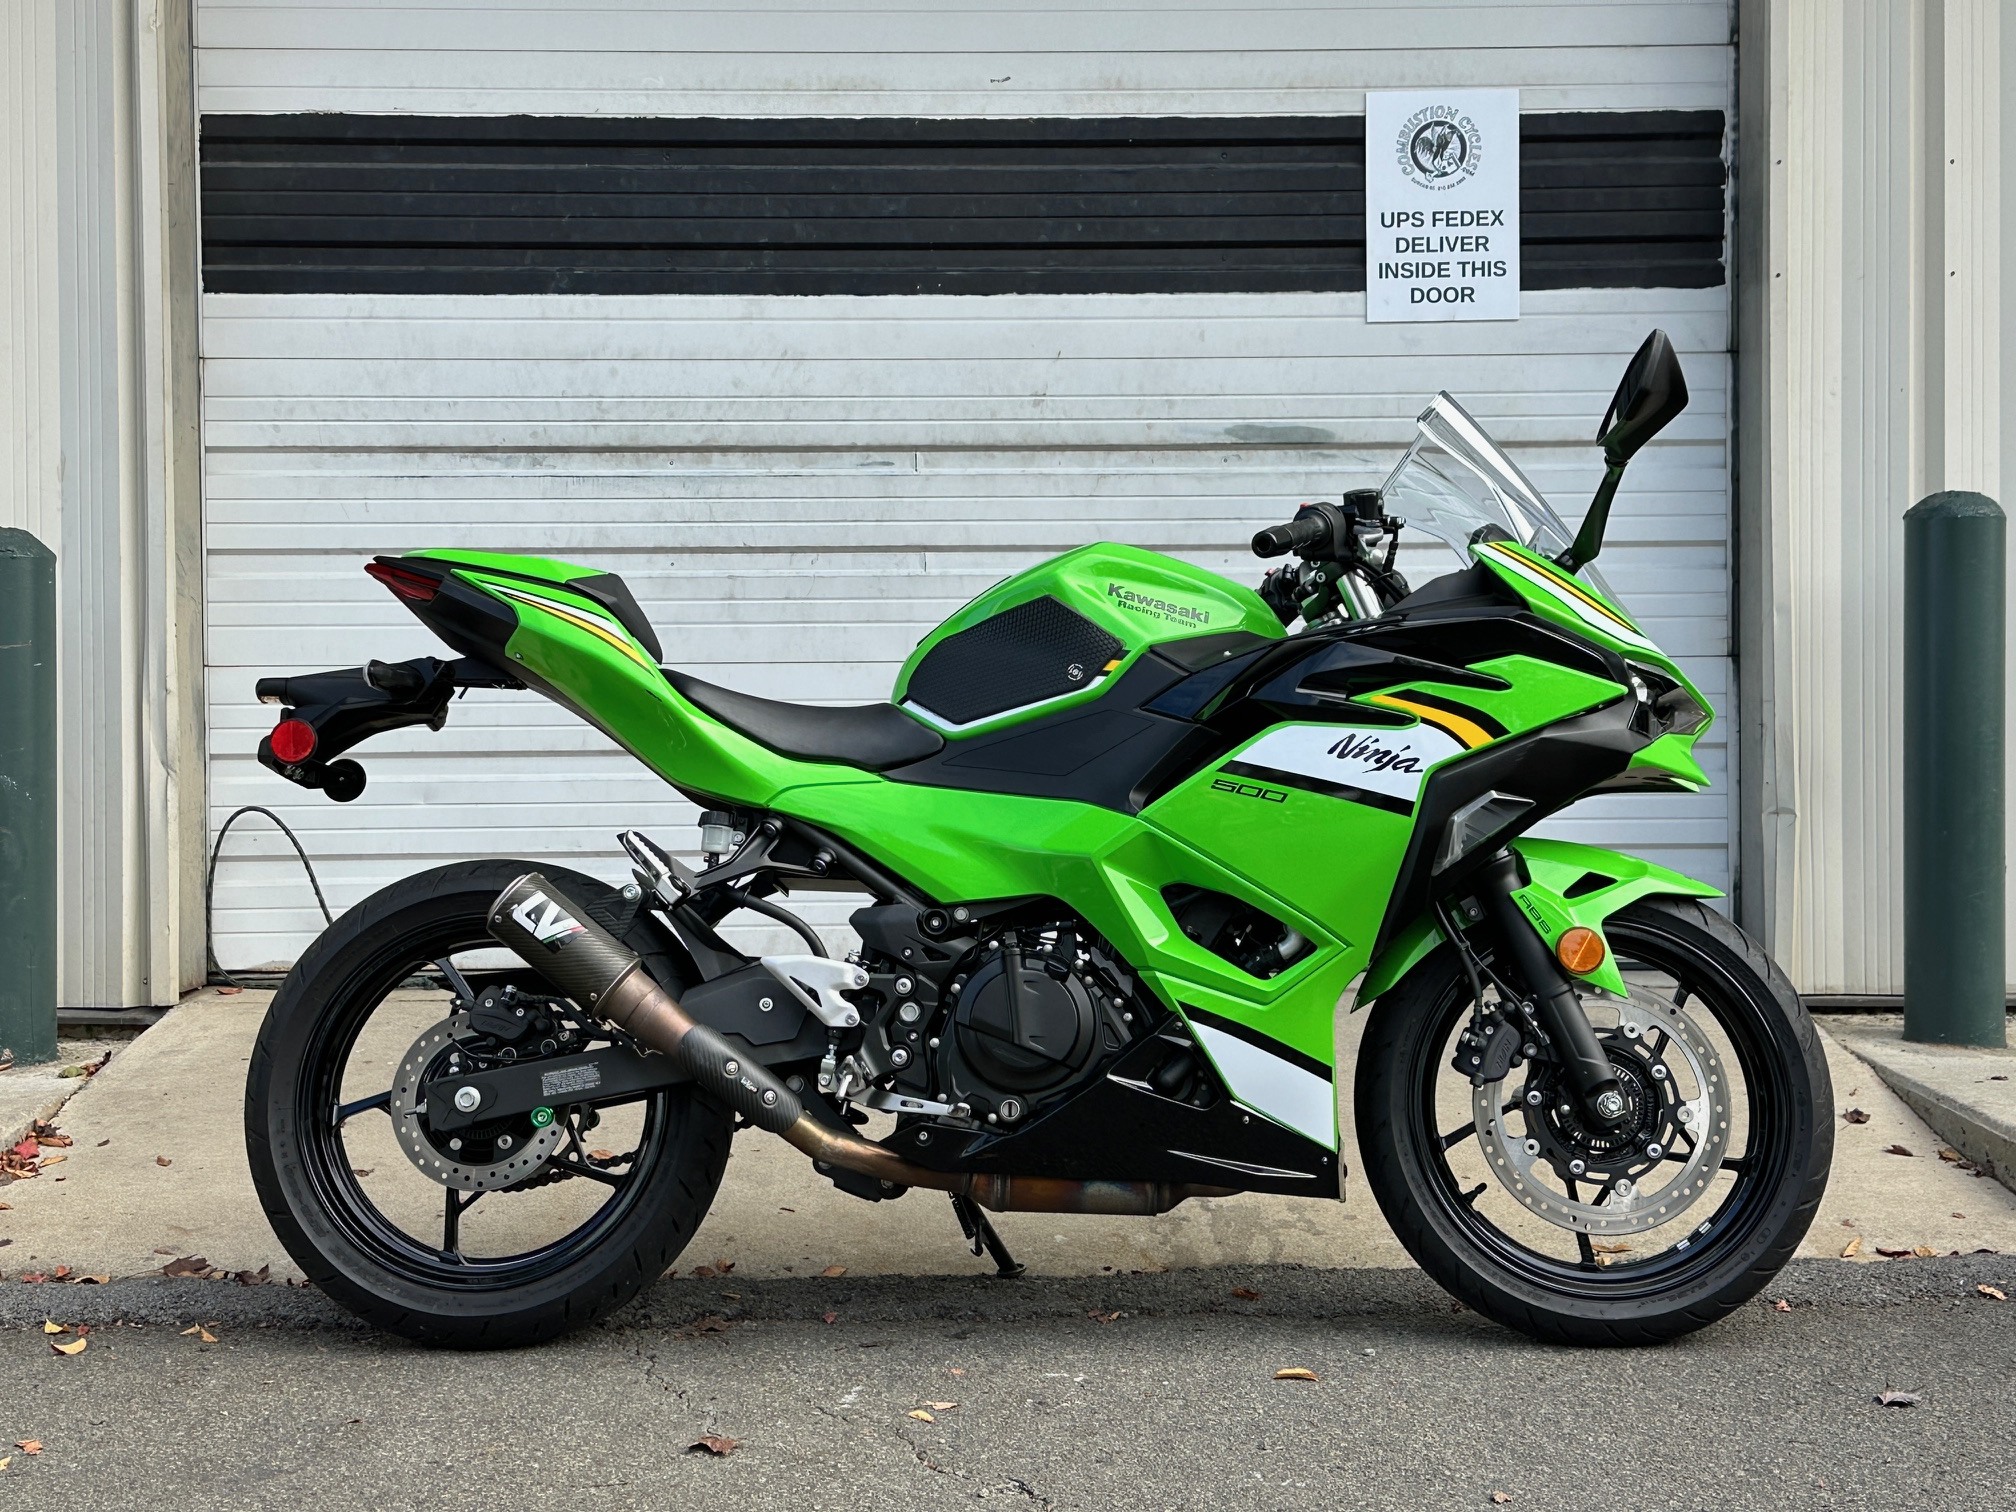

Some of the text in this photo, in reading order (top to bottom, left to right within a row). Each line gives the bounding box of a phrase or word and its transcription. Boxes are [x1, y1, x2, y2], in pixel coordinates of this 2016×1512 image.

[1396, 105, 1482, 176] COMBUSTION CYCLES
[1380, 210, 1504, 228] UPS FEDEX
[1395, 235, 1490, 253] DELIVER
[1378, 260, 1507, 279] INSIDE THIS
[1410, 286, 1476, 303] DOOR
[1107, 583, 1210, 624] Kawasaki
[1117, 600, 1197, 628] Racing Team
[1327, 733, 1423, 773] Ninja
[1211, 779, 1289, 803] 500
[1518, 894, 1552, 934] ABS
